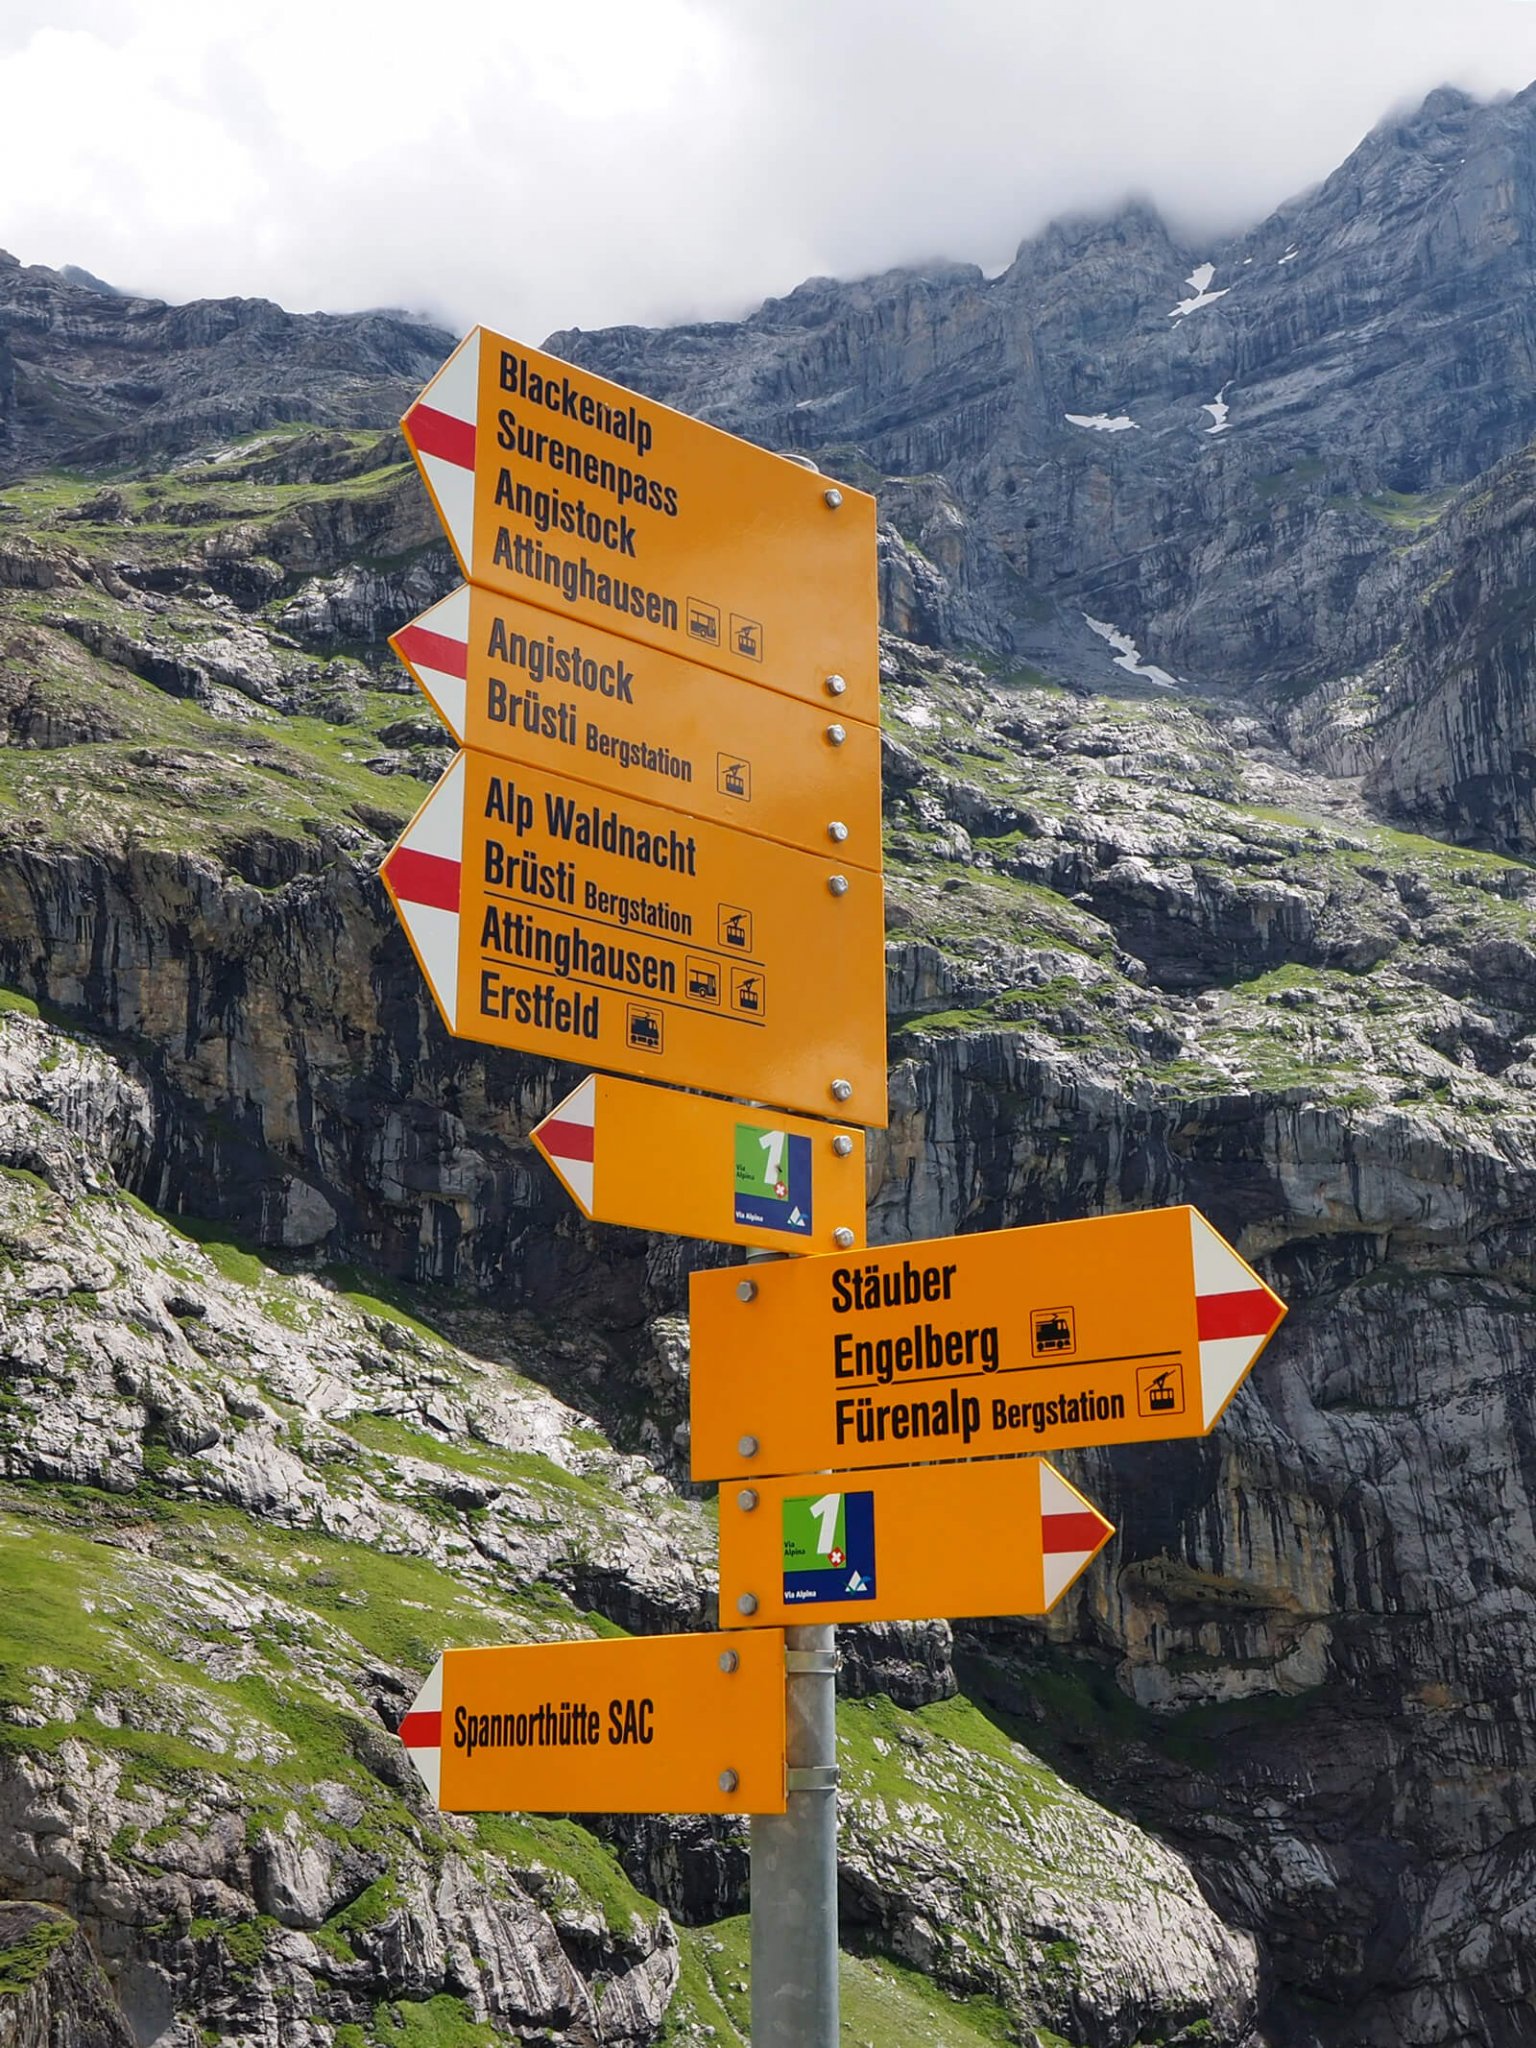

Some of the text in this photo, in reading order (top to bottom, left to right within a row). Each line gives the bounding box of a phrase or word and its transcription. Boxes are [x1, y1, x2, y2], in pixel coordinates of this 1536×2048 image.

[500, 351, 652, 455] Blackenalp
[497, 409, 679, 517] Surenenpass
[494, 468, 636, 558] Angistock
[493, 526, 678, 630] Attinghausen
[488, 618, 634, 704] Angistock
[487, 678, 692, 783] Brüsti Bergstation
[484, 776, 697, 876] Alp Waldnacht
[484, 840, 692, 936] Brüsti Bergstation
[481, 905, 676, 994] Attinghausen
[480, 970, 599, 1040] Erstfeld
[759, 1130, 785, 1185] 1
[735, 1211, 764, 1223] Via Alpina
[832, 1260, 957, 1313] Stäuber
[834, 1323, 999, 1384] Engelberg
[836, 1388, 1125, 1445] Fürenalp Bergstation
[784, 1549, 806, 1557] Alpina
[809, 1493, 841, 1554] 1
[784, 1589, 817, 1600] Via Alpina
[454, 1698, 654, 1758] Spannorthütte SAC
